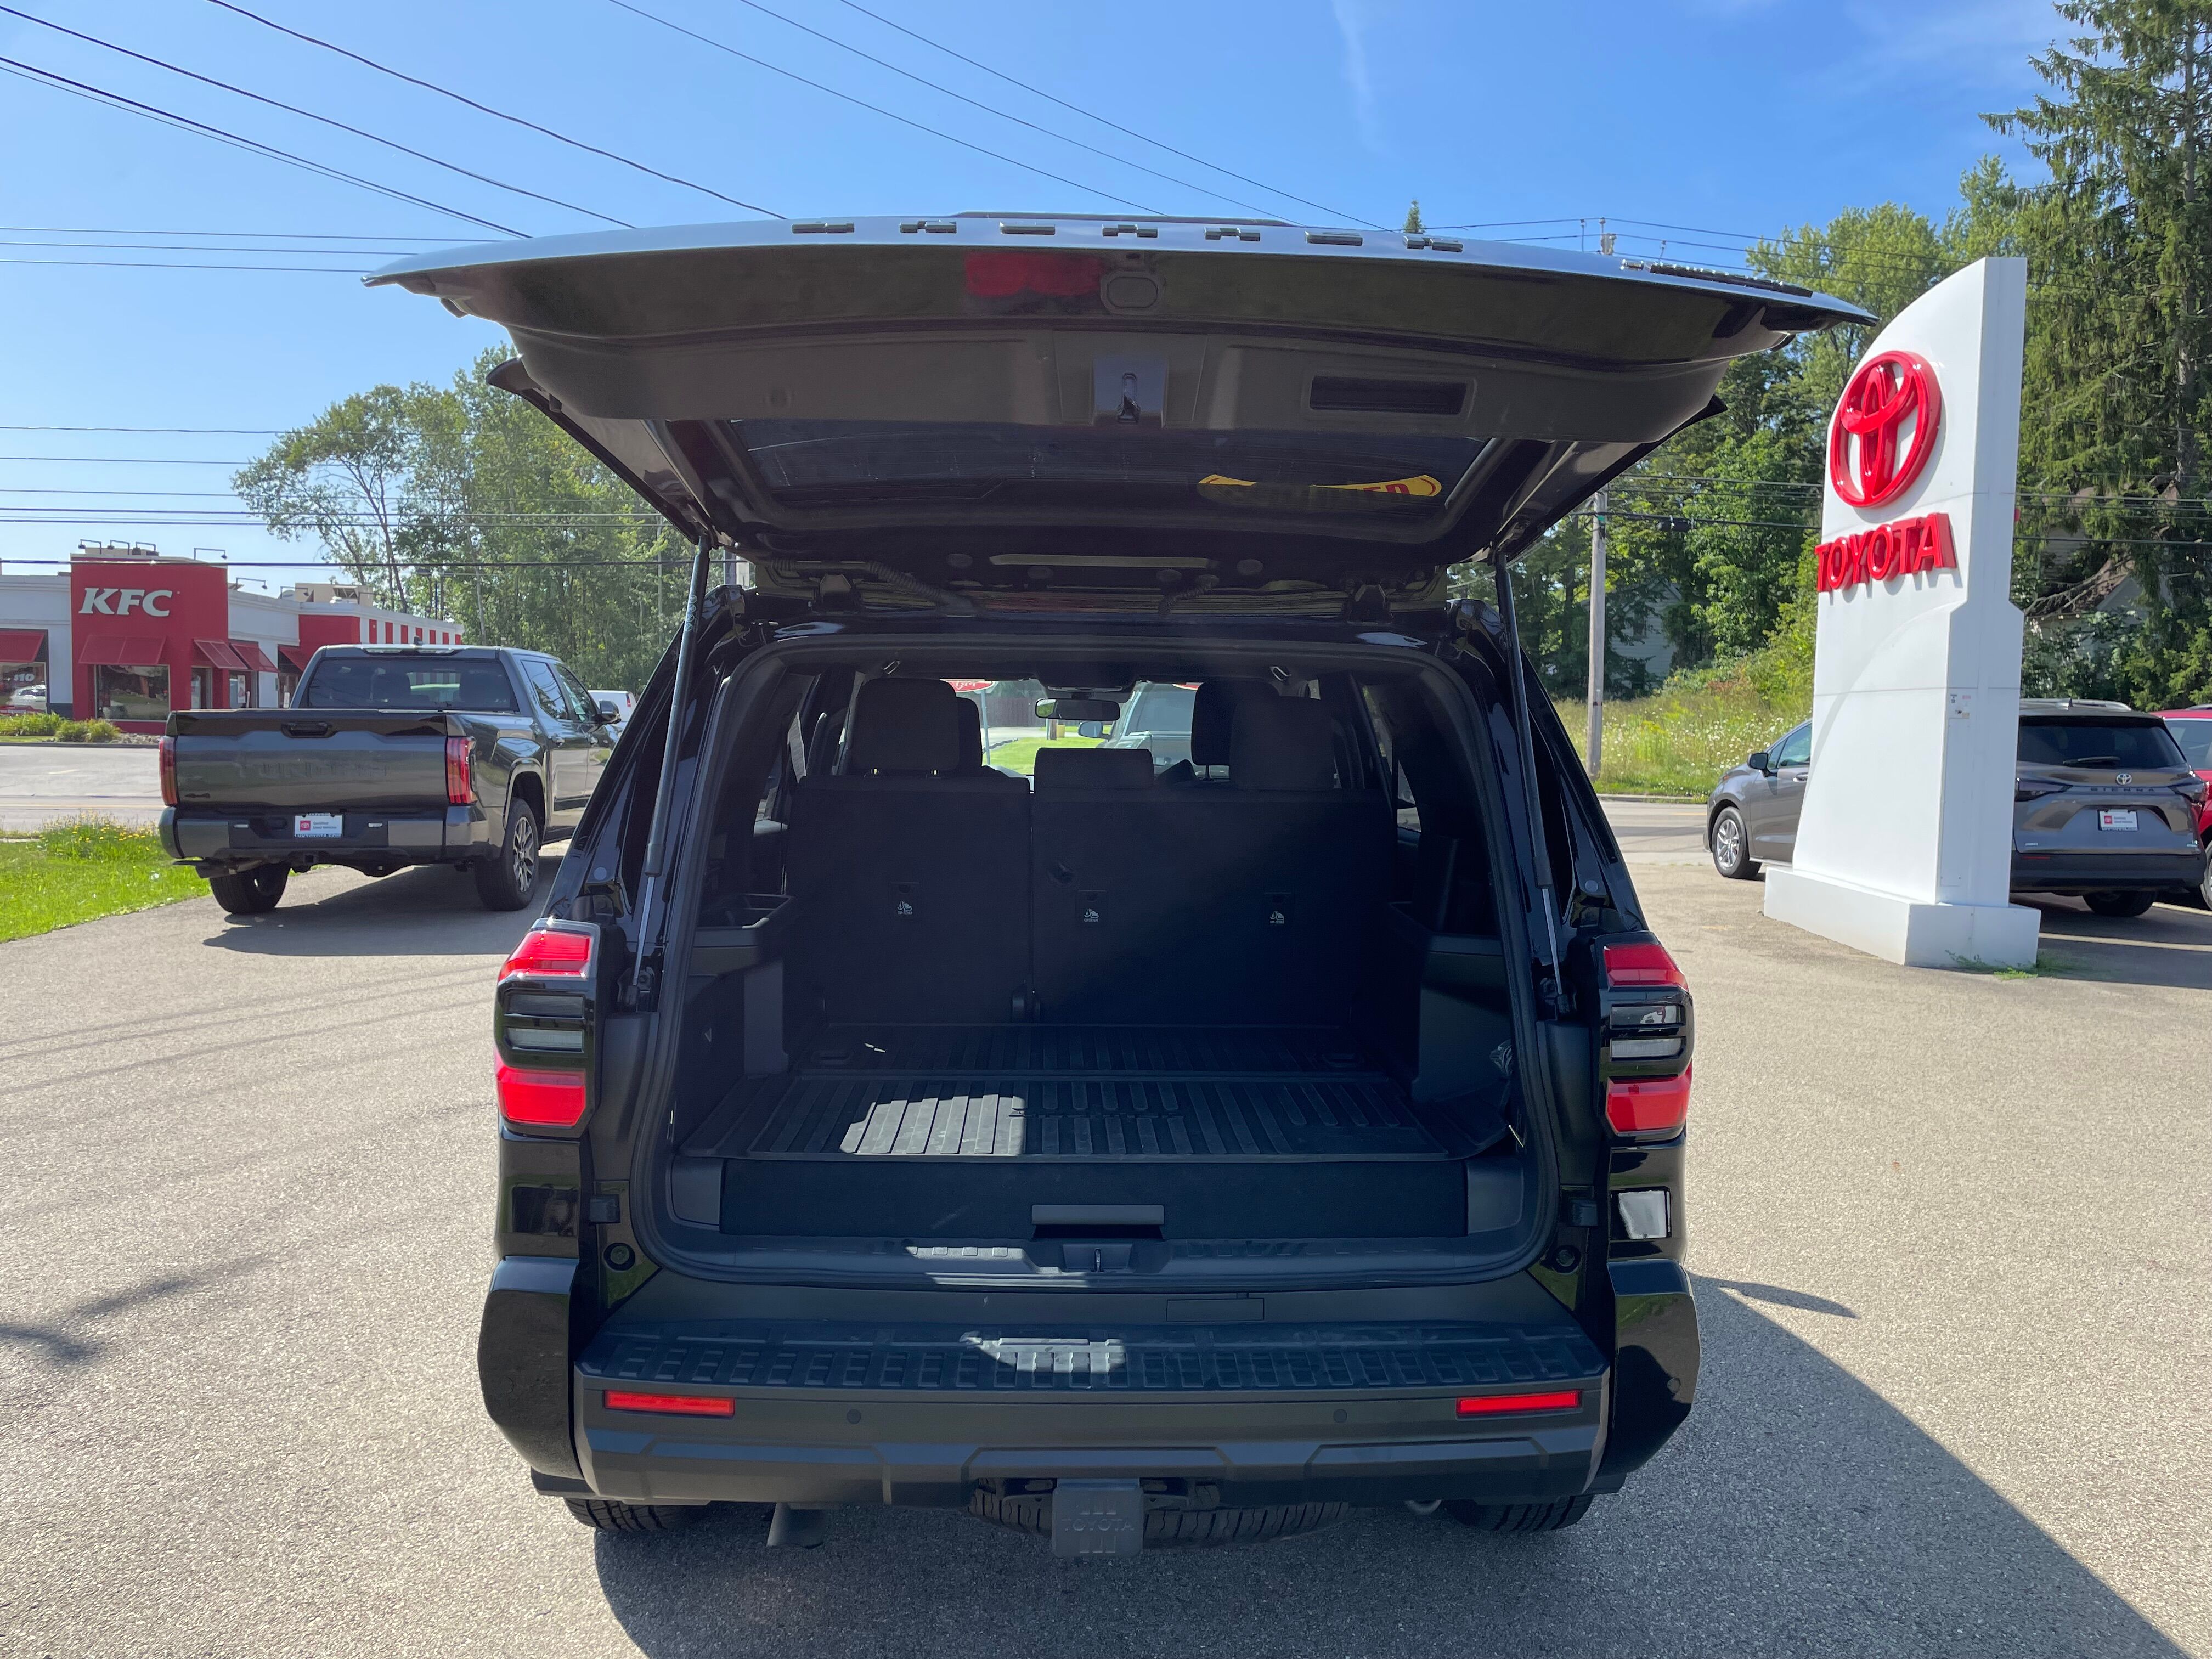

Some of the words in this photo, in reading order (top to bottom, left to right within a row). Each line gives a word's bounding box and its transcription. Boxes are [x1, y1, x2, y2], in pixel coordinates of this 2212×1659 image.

[1815, 512, 1956, 592] TOYOTA
[78, 588, 173, 617] KFC
[14, 673, 35, 681] $10
[1062, 1519, 1135, 1531] TOYOTA
